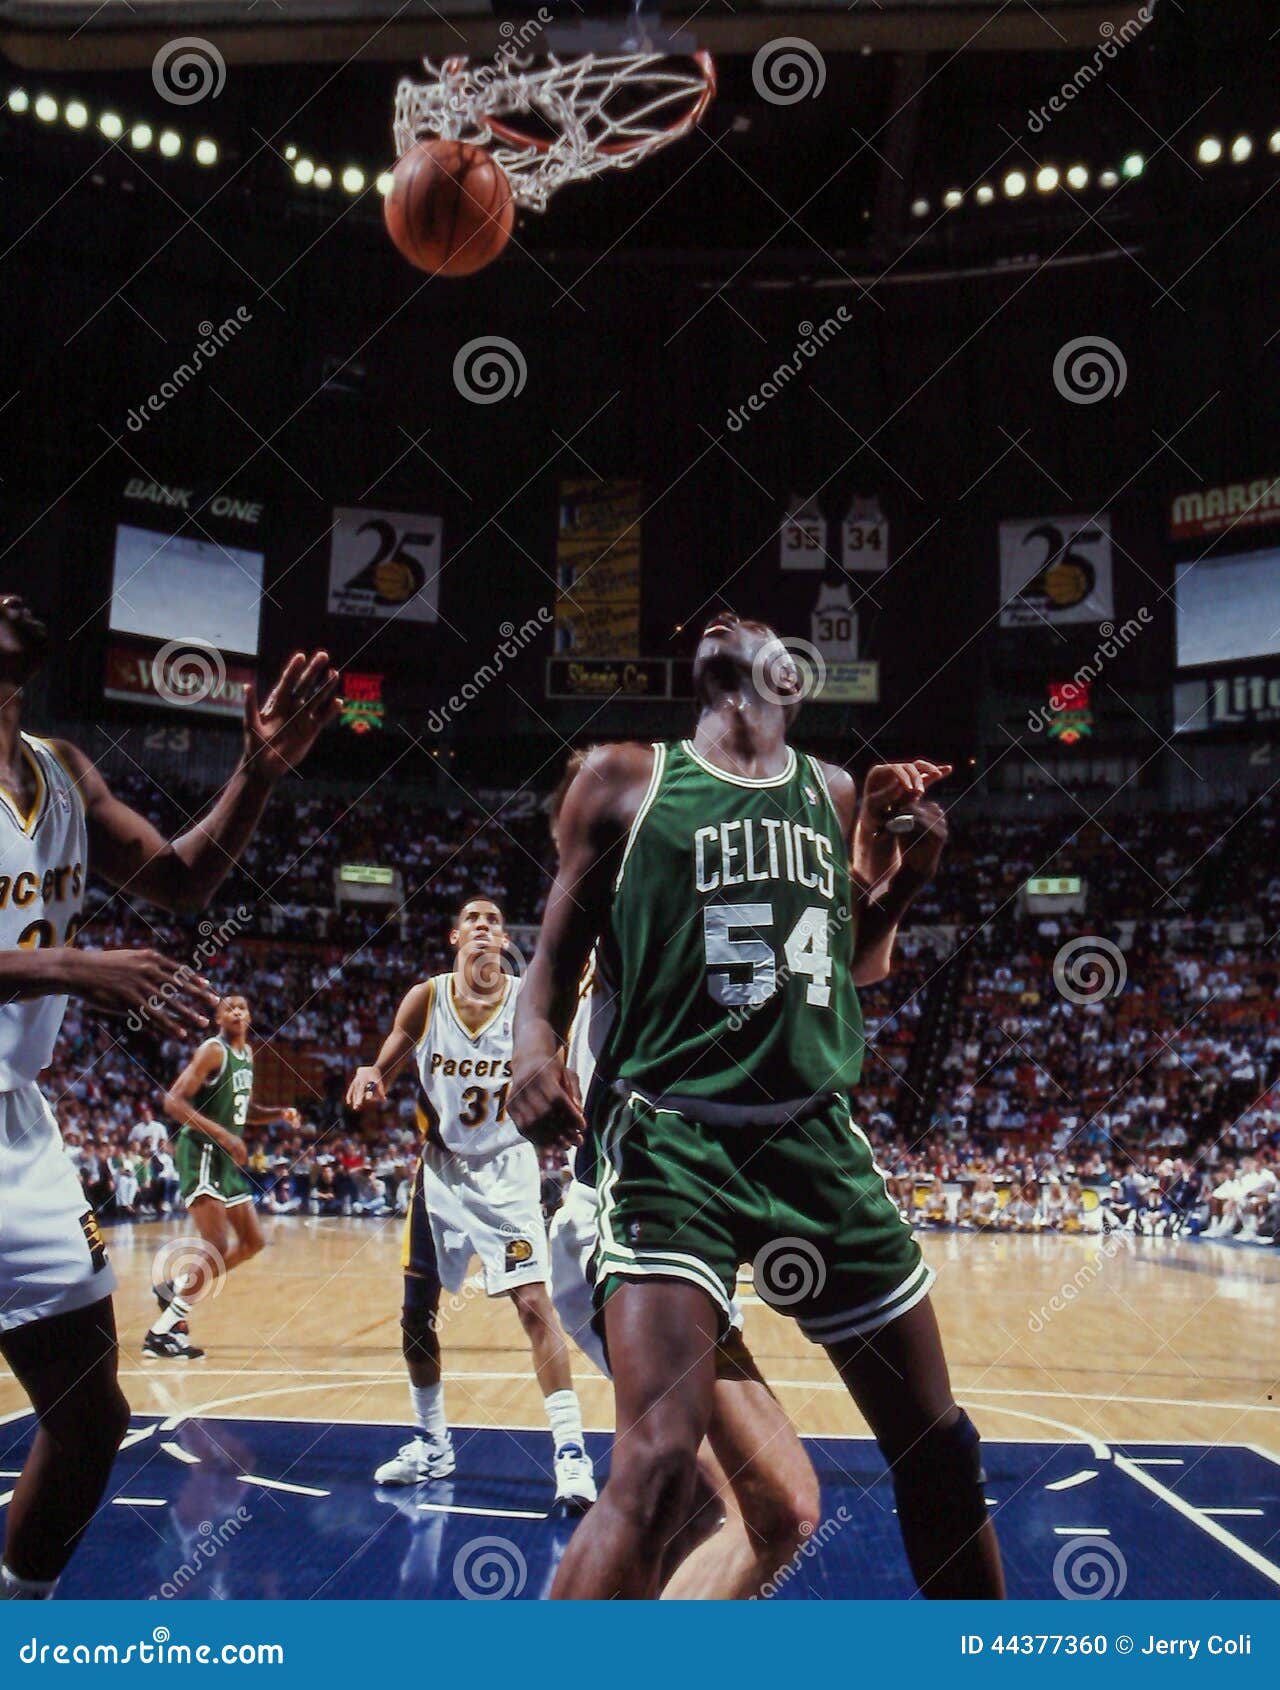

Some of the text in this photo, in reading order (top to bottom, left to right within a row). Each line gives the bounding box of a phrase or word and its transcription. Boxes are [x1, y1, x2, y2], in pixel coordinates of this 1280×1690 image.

[124, 477, 264, 523] BANK ONE
[787, 526, 820, 550] 35
[848, 526, 881, 551] 34
[818, 618, 852, 641] 30
[694, 817, 835, 900] CELTICS
[703, 903, 833, 1008] 54
[430, 1053, 513, 1078] Pacers
[233, 1094, 250, 1126] 3
[458, 1083, 510, 1129] 31
